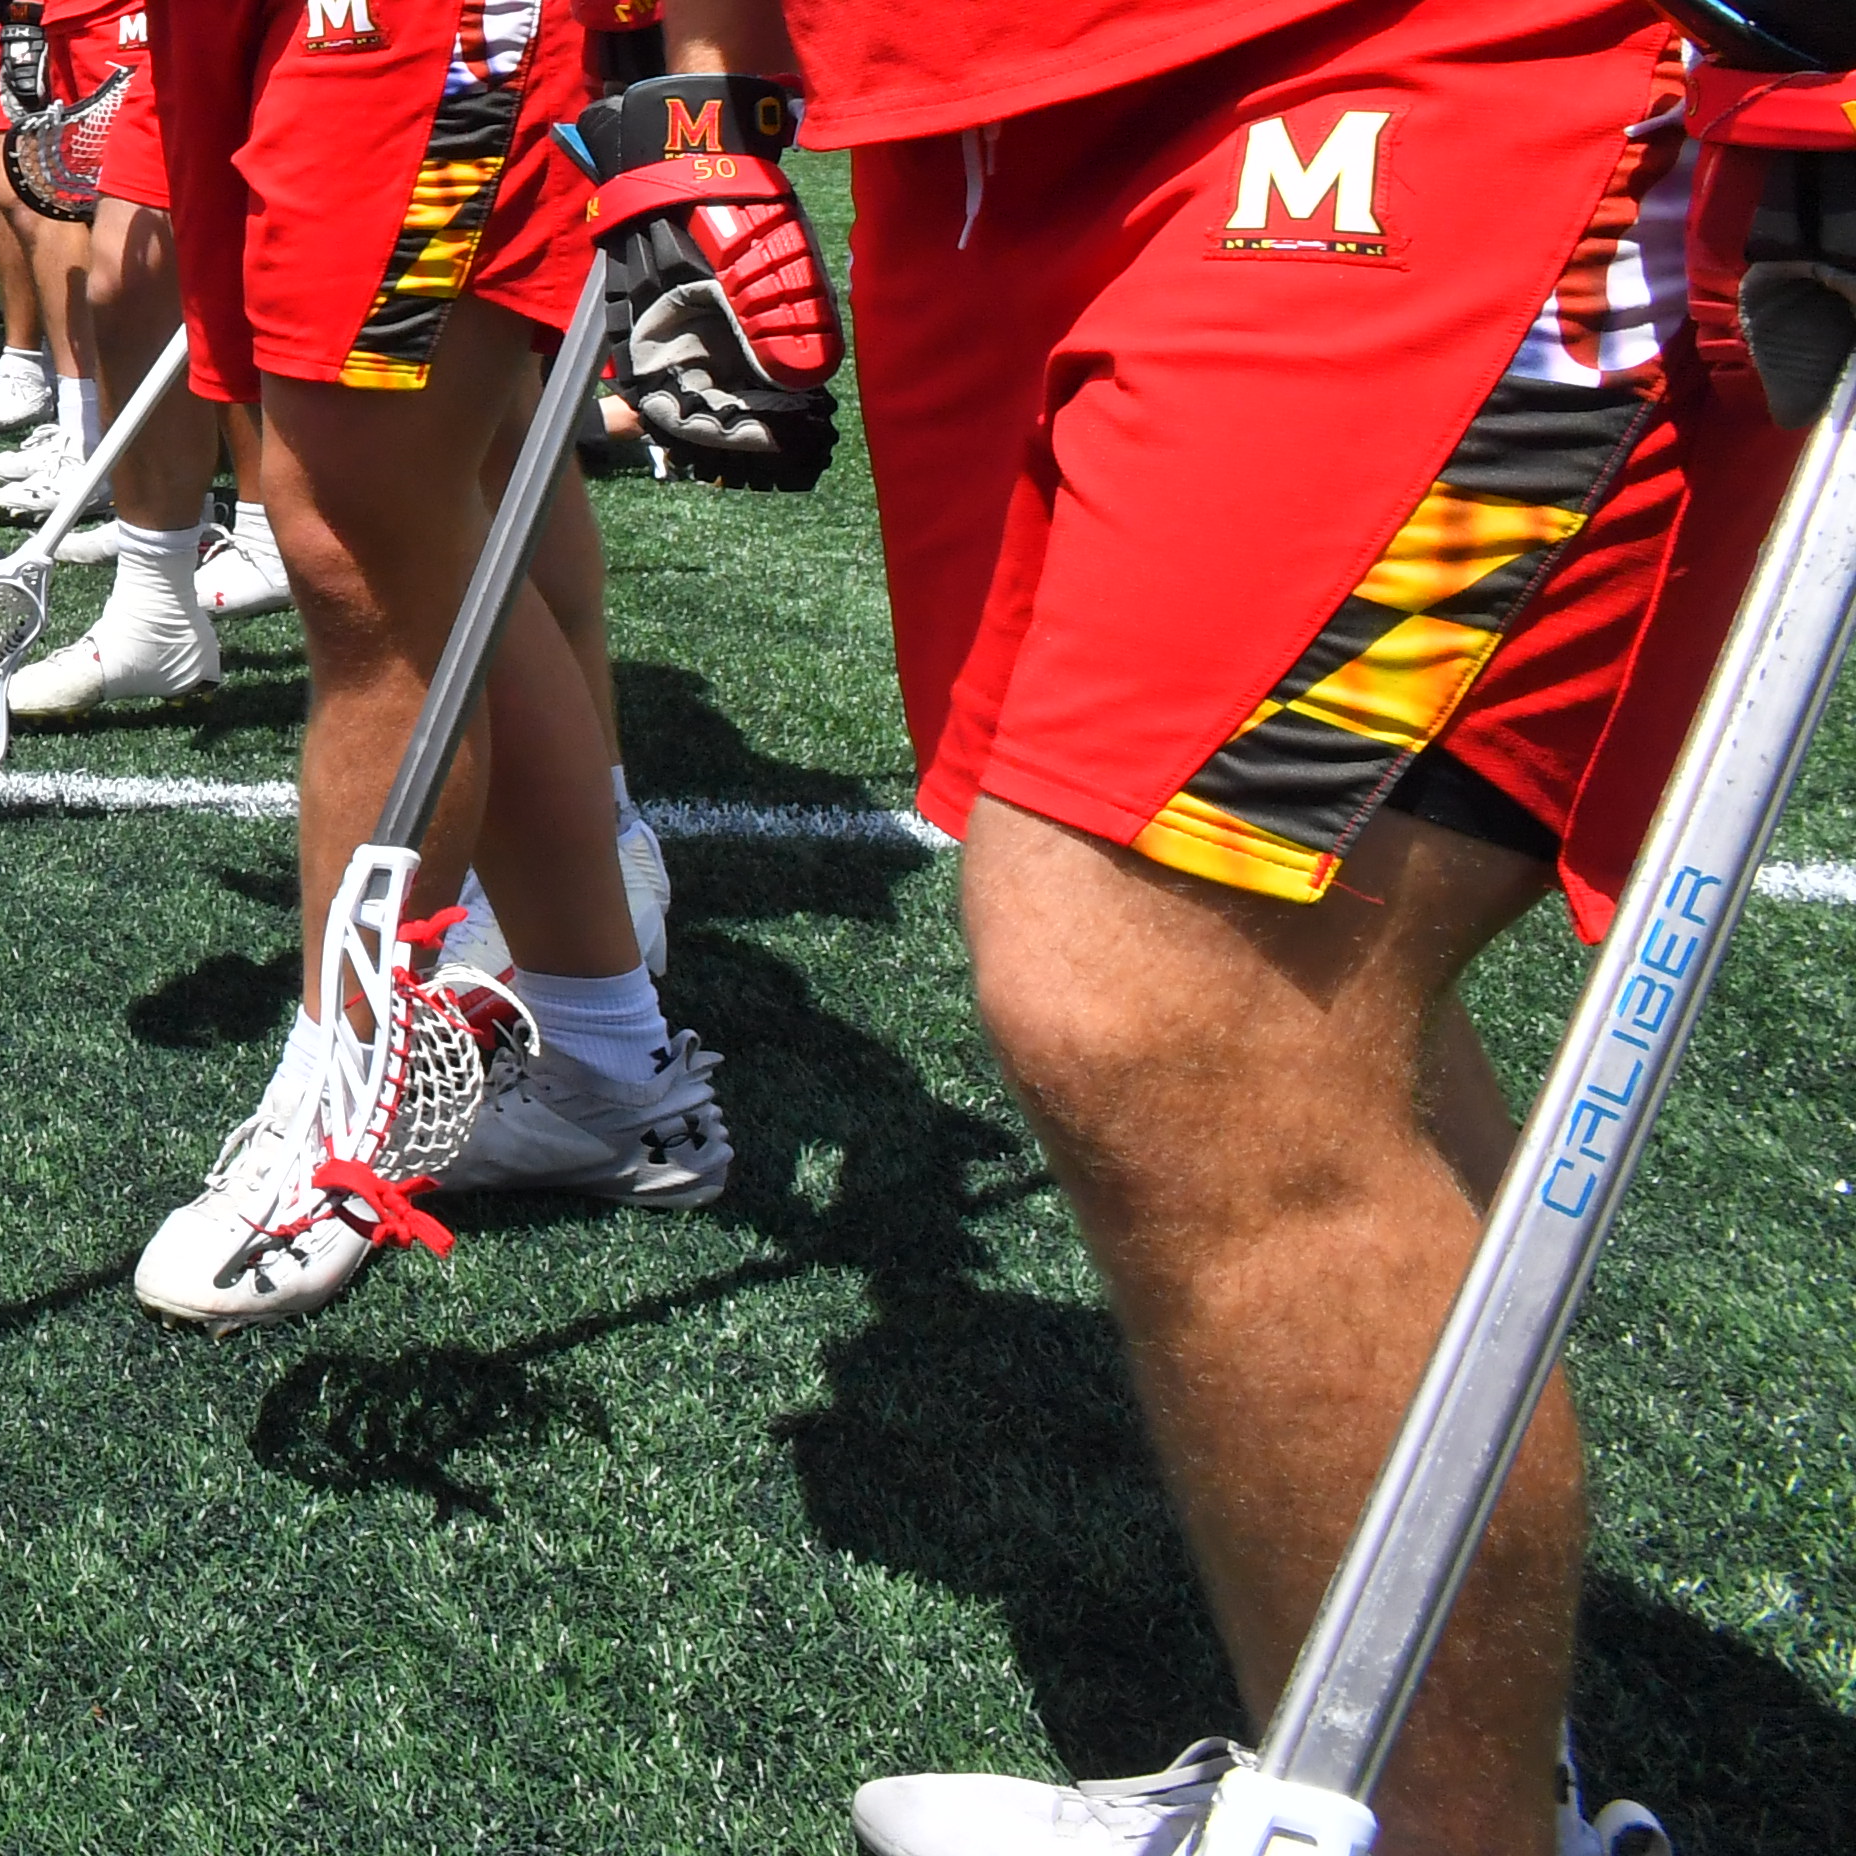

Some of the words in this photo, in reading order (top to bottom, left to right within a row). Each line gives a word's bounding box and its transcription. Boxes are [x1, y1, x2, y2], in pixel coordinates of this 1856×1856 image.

[118, 12, 148, 45] M
[664, 98, 723, 152] M
[693, 157, 737, 181] 50
[1225, 111, 1390, 235] M
[1541, 866, 1721, 1220] CALIBER
